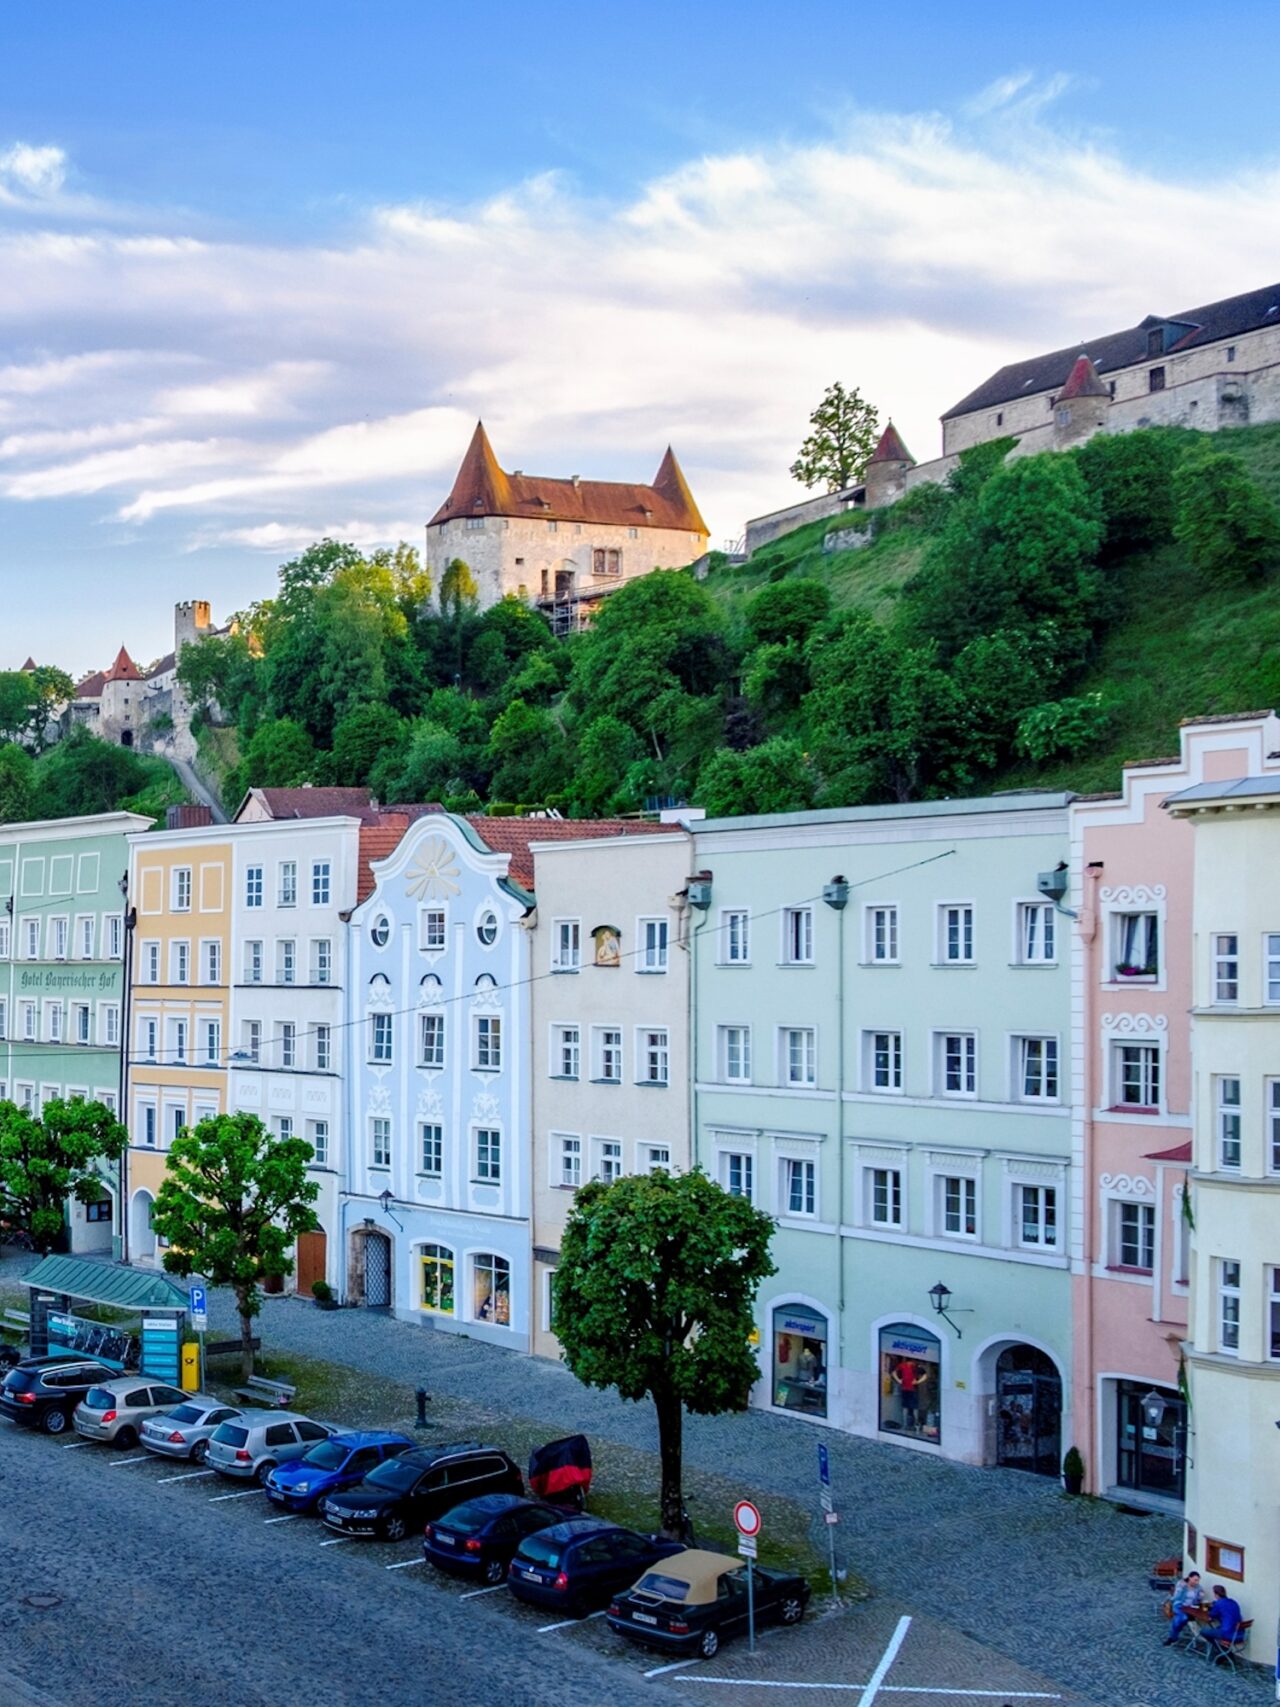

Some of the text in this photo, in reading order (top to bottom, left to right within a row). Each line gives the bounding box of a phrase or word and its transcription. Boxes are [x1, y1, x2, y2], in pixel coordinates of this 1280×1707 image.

[21, 971, 117, 991] Hotel Bayerischer Hof
[193, 1290, 203, 1306] P
